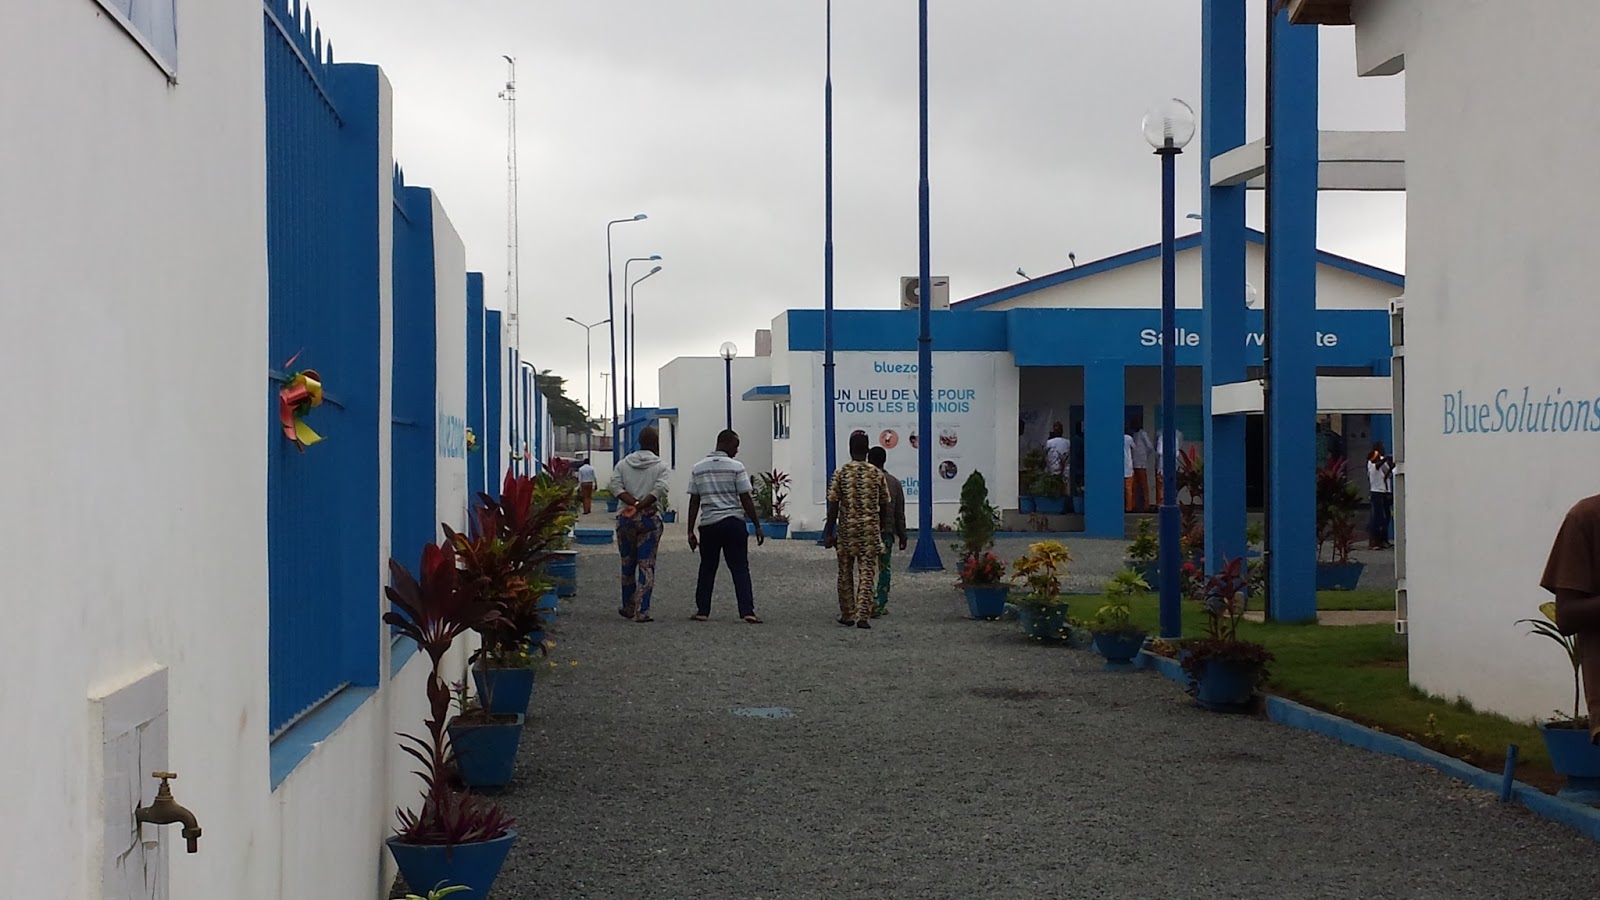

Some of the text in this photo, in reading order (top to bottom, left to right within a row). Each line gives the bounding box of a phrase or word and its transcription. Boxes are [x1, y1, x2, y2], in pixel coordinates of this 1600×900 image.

[874, 360, 933, 373] bluezo
[858, 389, 887, 400] LIEU
[891, 389, 909, 400] DE
[937, 389, 975, 400] POUR
[838, 402, 970, 413] TOUS LES BINOIS
